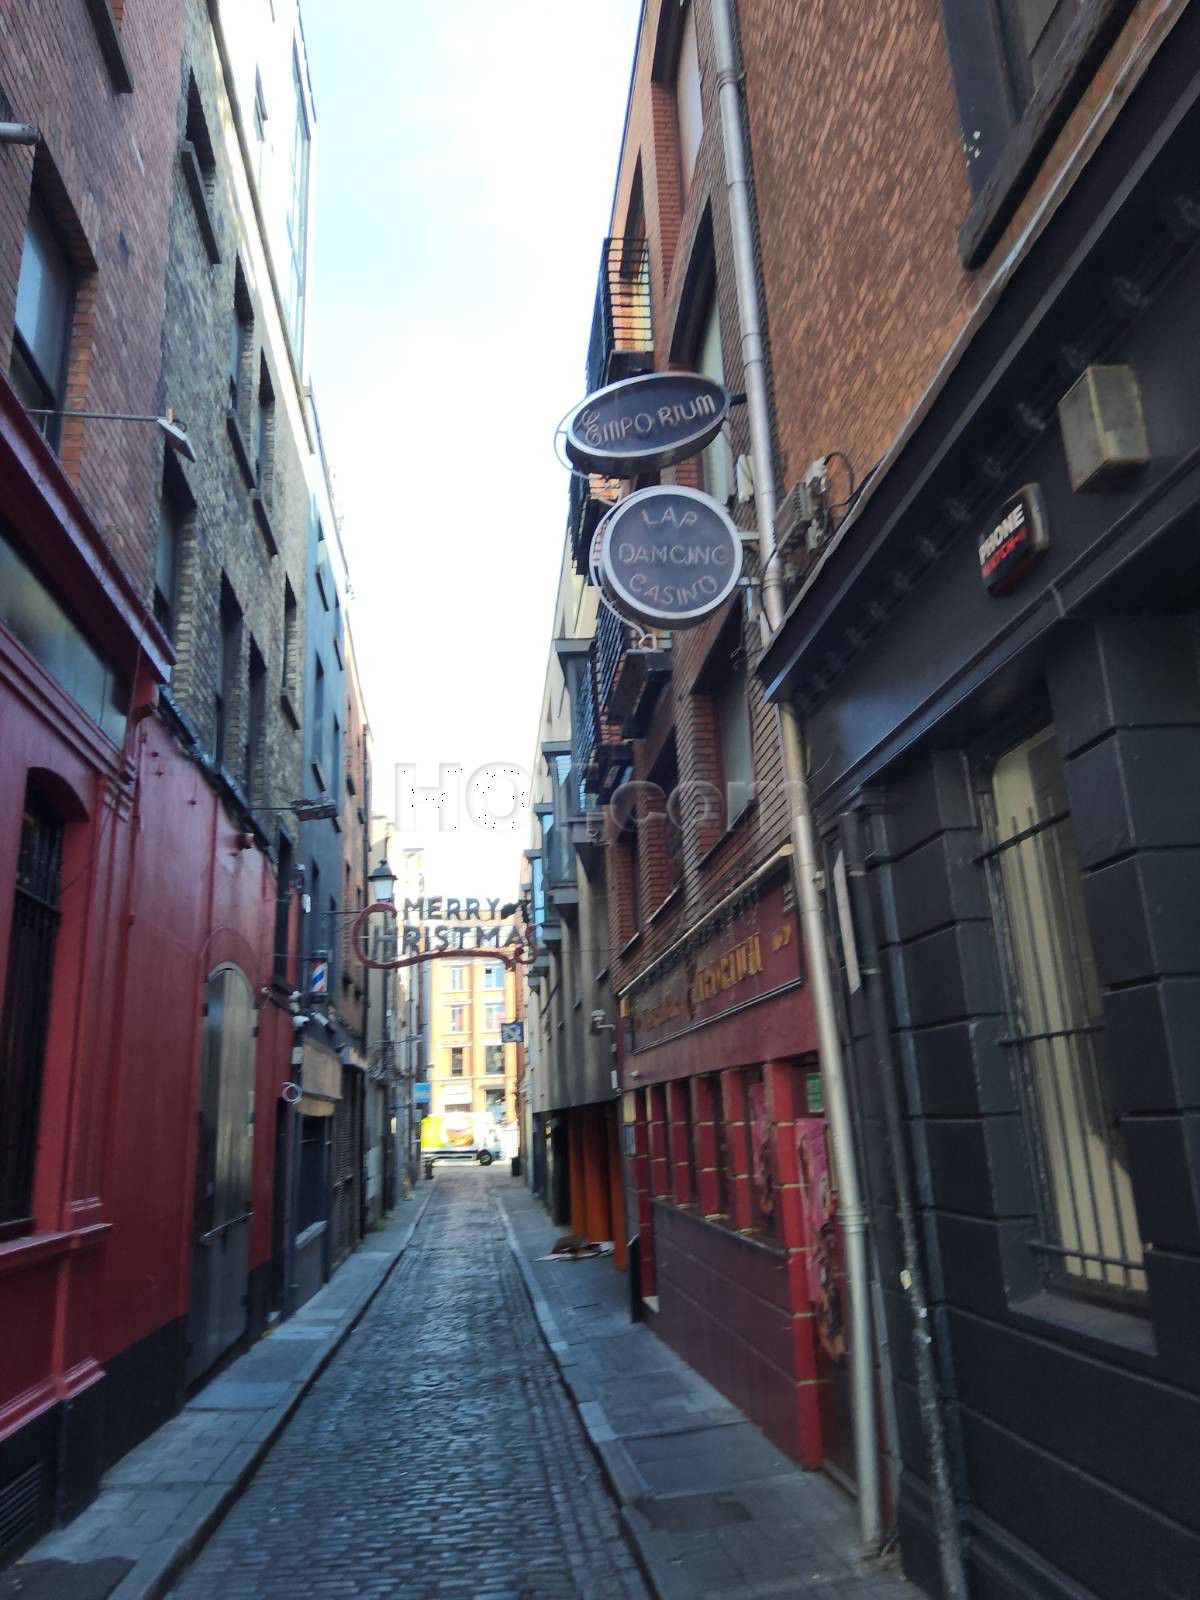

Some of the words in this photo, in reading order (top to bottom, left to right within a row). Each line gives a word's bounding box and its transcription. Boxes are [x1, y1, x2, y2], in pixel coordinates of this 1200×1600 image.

[641, 506, 698, 527] LAP
[629, 575, 717, 605] CASINO
[403, 897, 502, 921] MERRY
